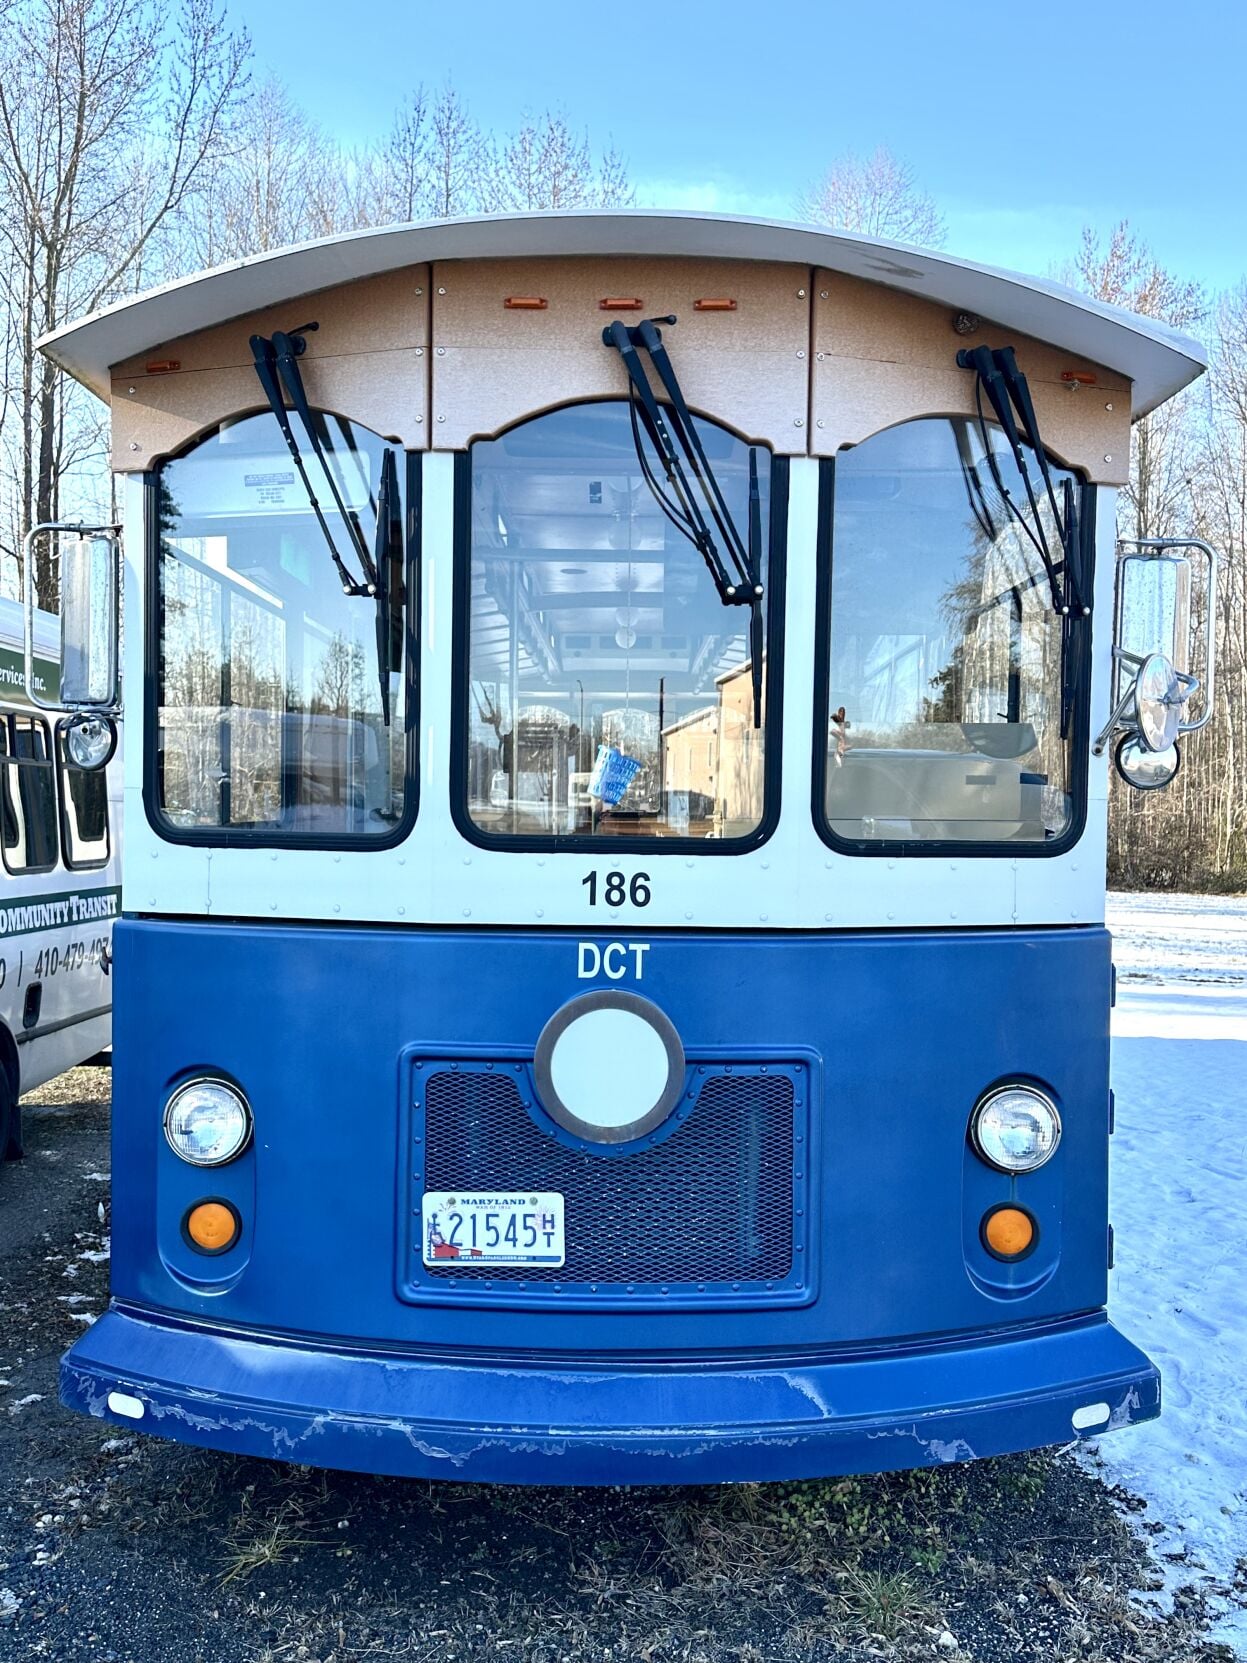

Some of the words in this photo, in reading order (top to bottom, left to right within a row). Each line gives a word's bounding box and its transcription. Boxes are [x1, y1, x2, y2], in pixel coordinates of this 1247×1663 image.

[582, 871, 651, 908] 186
[34, 936, 112, 979] 410-479-497
[578, 942, 650, 980] DCT
[461, 1198, 526, 1206] MARYLAND
[449, 1212, 537, 1248] 21545
